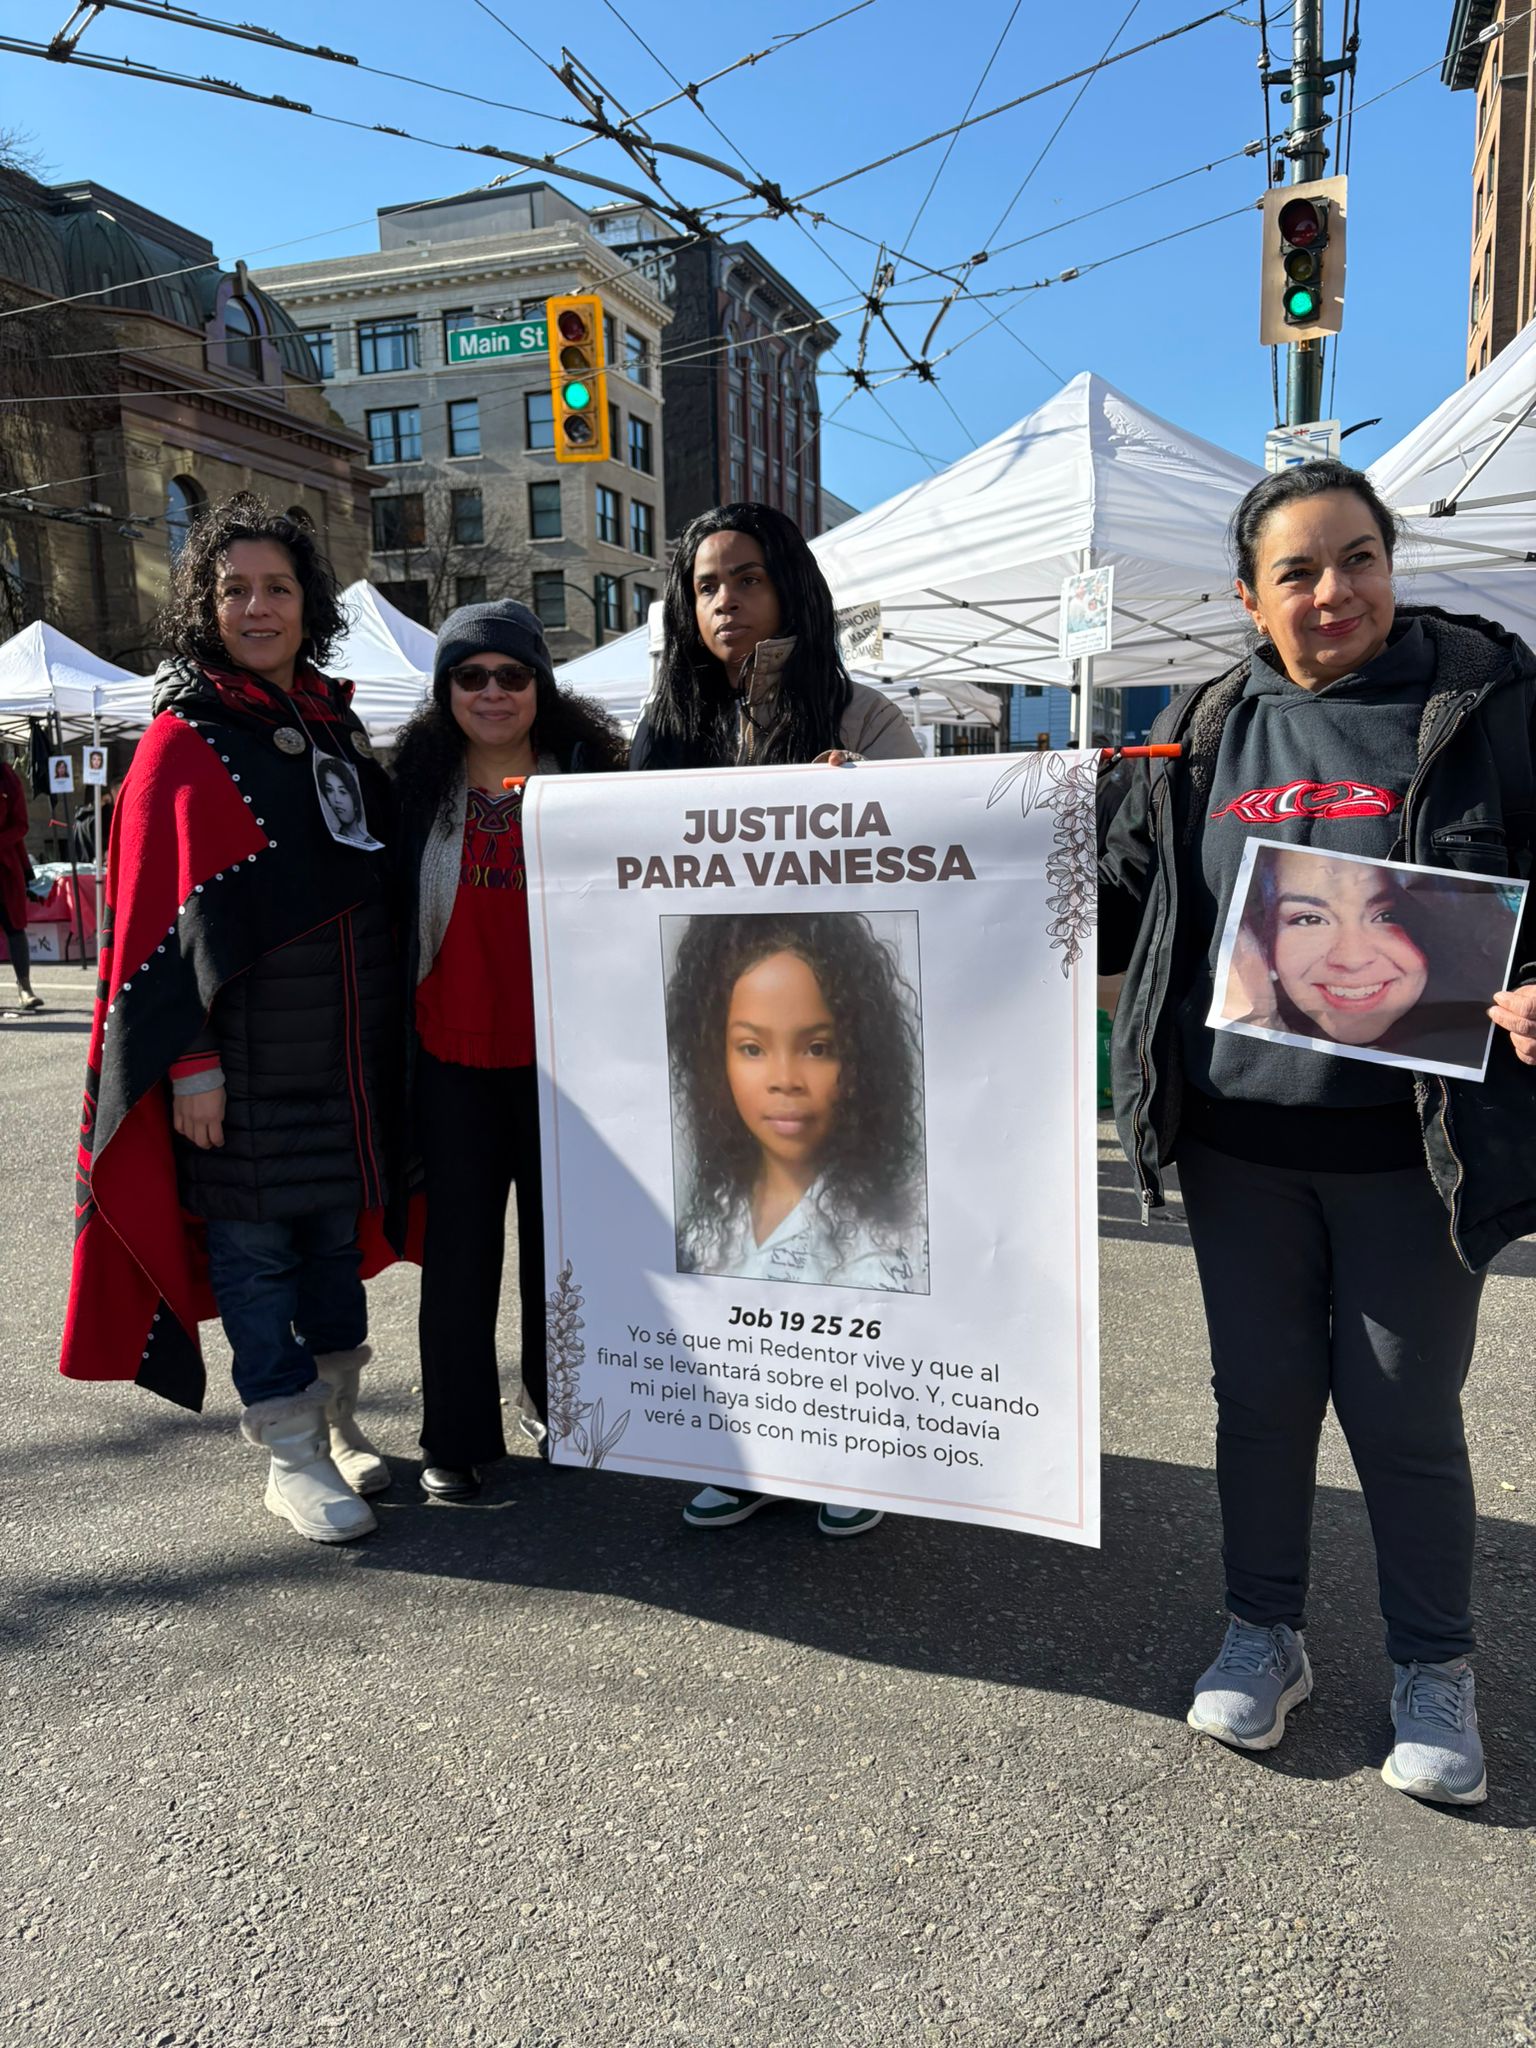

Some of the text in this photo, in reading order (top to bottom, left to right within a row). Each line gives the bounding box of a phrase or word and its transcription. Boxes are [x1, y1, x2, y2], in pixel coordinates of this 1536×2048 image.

[459, 326, 545, 357] Main St
[682, 800, 892, 845] JUSTICIA
[616, 844, 977, 890] PARA VANESSA
[727, 1305, 882, 1341] Job 19 25 26
[627, 1324, 999, 1384] Yo sé que mi Redentor vive y que al
[597, 1347, 1040, 1418] final se levantará sobre el polvo. Y, cuando
[630, 1379, 1001, 1442] mi piel haya sido destruida, todavía
[644, 1408, 984, 1468] veré a Dios con mis propios ojos.
